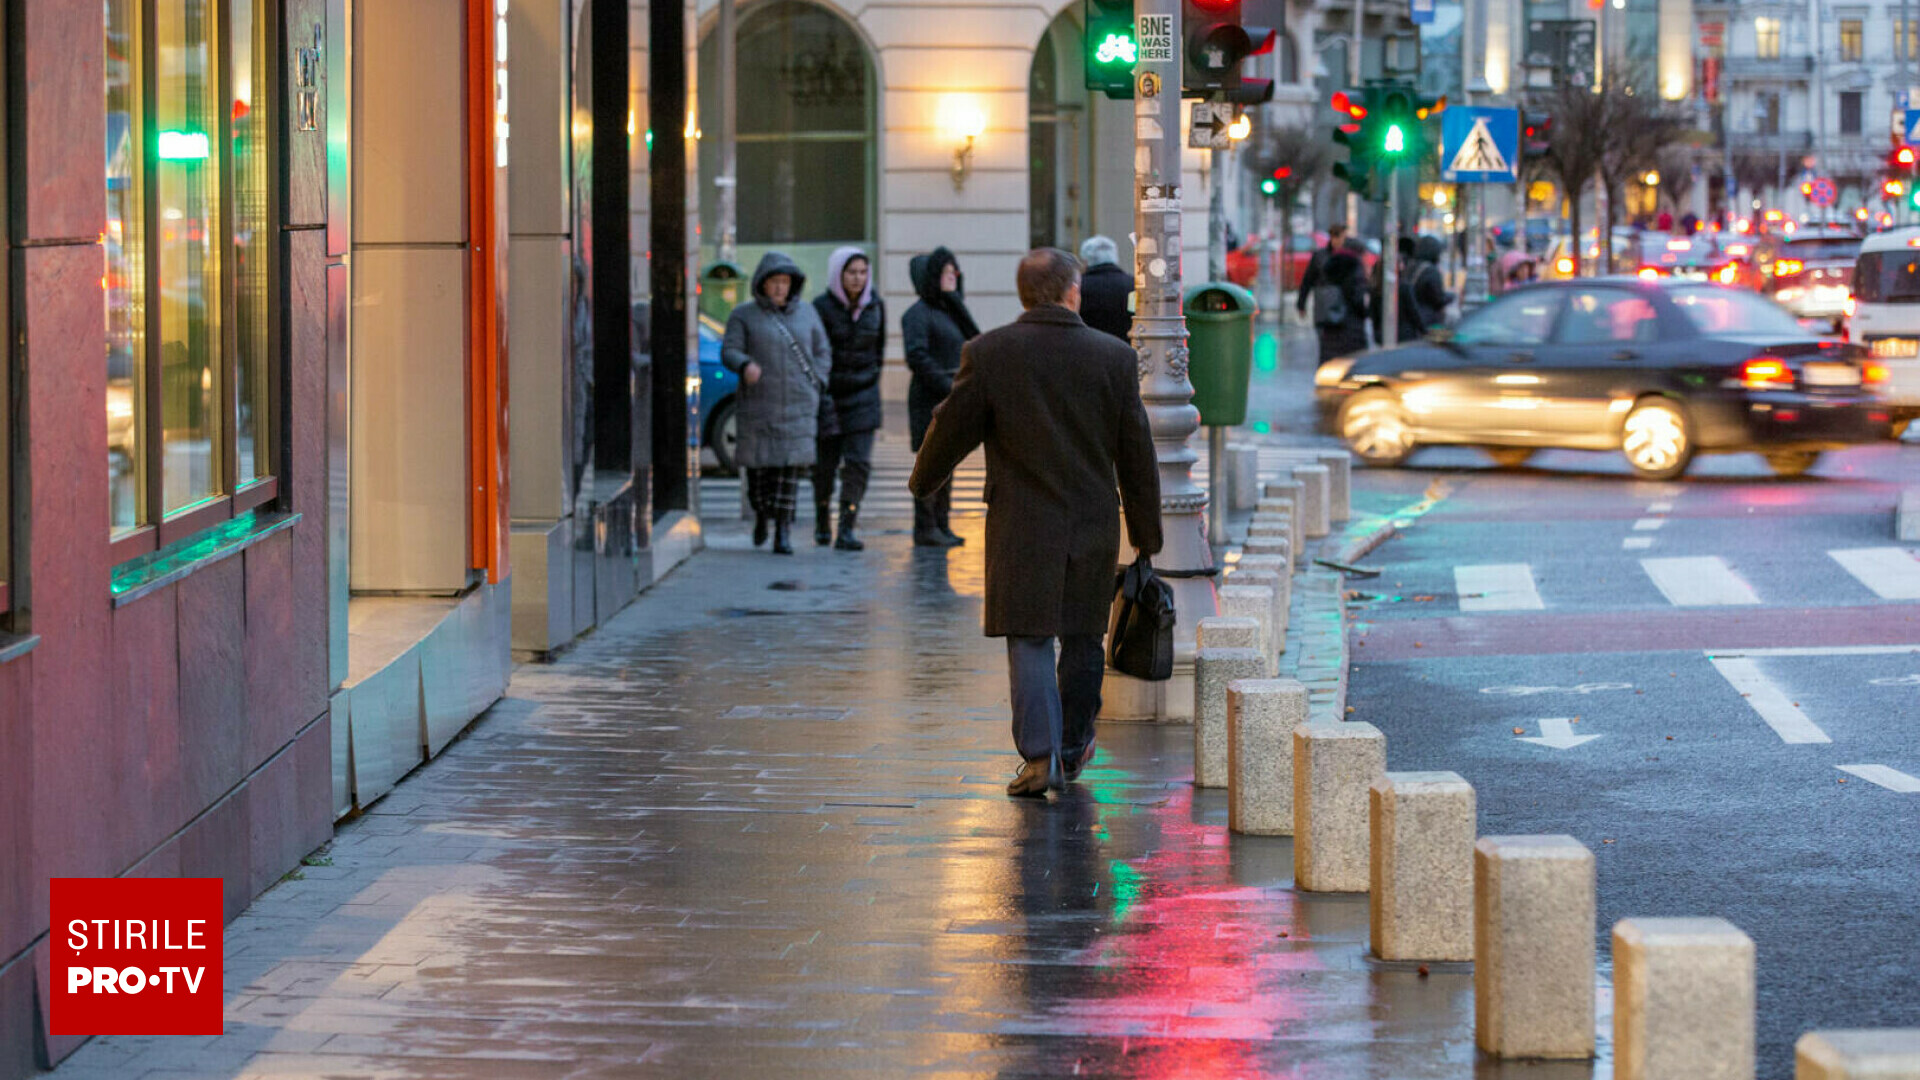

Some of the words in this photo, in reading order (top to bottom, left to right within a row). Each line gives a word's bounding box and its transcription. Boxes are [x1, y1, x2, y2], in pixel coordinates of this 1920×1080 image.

[1140, 16, 1171, 36] BNE
[1141, 36, 1171, 48] WAS
[1140, 48, 1171, 59] HERE
